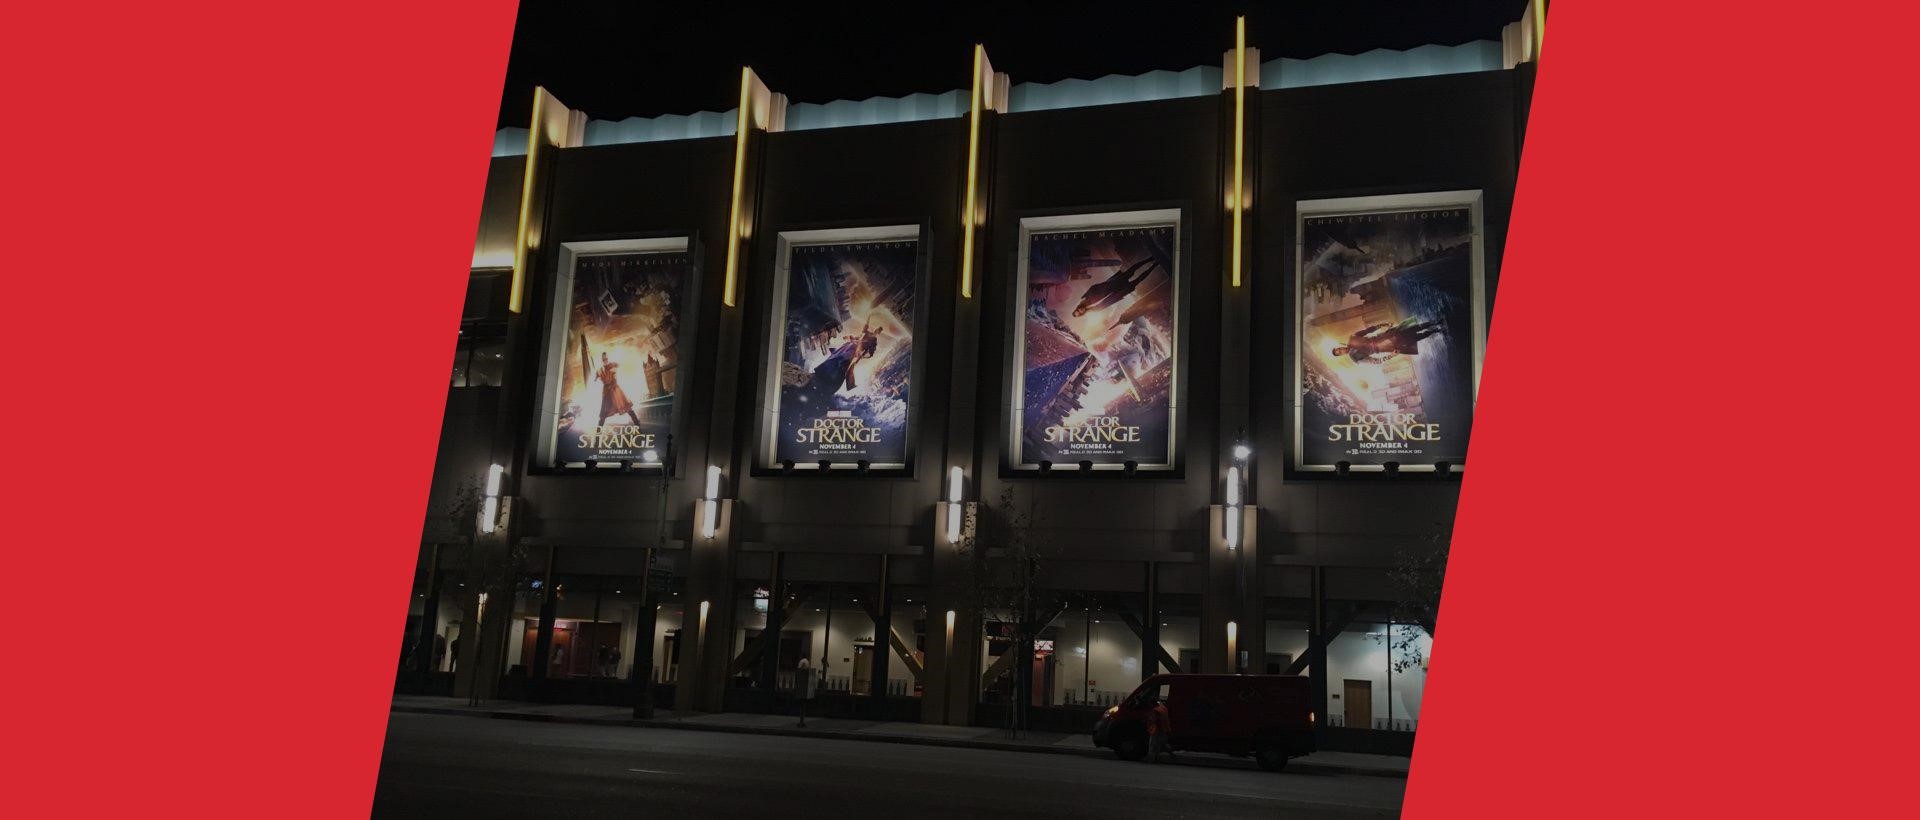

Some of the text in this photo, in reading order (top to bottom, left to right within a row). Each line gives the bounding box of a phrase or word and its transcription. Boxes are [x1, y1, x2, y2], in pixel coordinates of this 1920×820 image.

[1033, 233, 1088, 241] RACHEL
[813, 418, 865, 429] DOCTOR
[1064, 416, 1121, 427] TOR
[1349, 413, 1417, 425] DOCTOR
[595, 425, 641, 434] DCTOR
[796, 427, 882, 443] STRANGE
[1043, 426, 1141, 442] STRANGE
[1328, 423, 1441, 441] STRANGE
[577, 433, 655, 448] STRANGE
